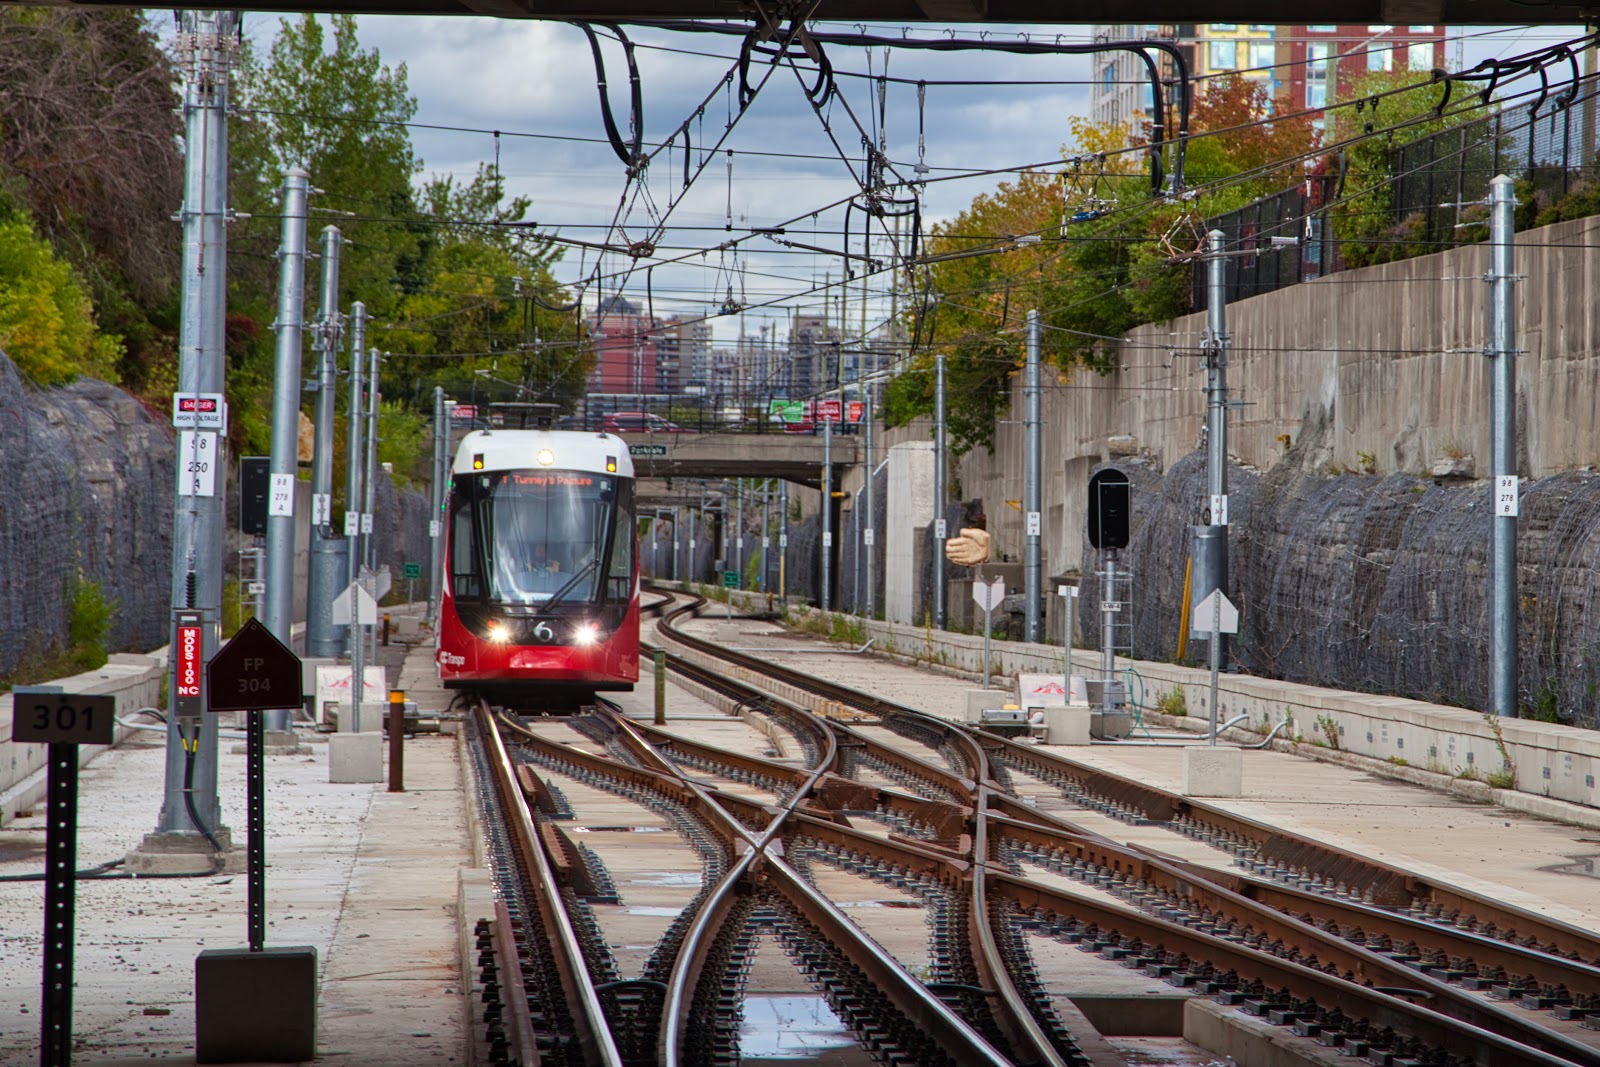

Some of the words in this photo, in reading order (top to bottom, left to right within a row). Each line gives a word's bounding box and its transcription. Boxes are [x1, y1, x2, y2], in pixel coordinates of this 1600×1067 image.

[183, 401, 213, 409] DAGER
[1501, 494, 1514, 502] 278
[244, 658, 265, 671] FP
[178, 686, 199, 695] NC
[238, 678, 272, 693] 304
[32, 704, 94, 732] 301
